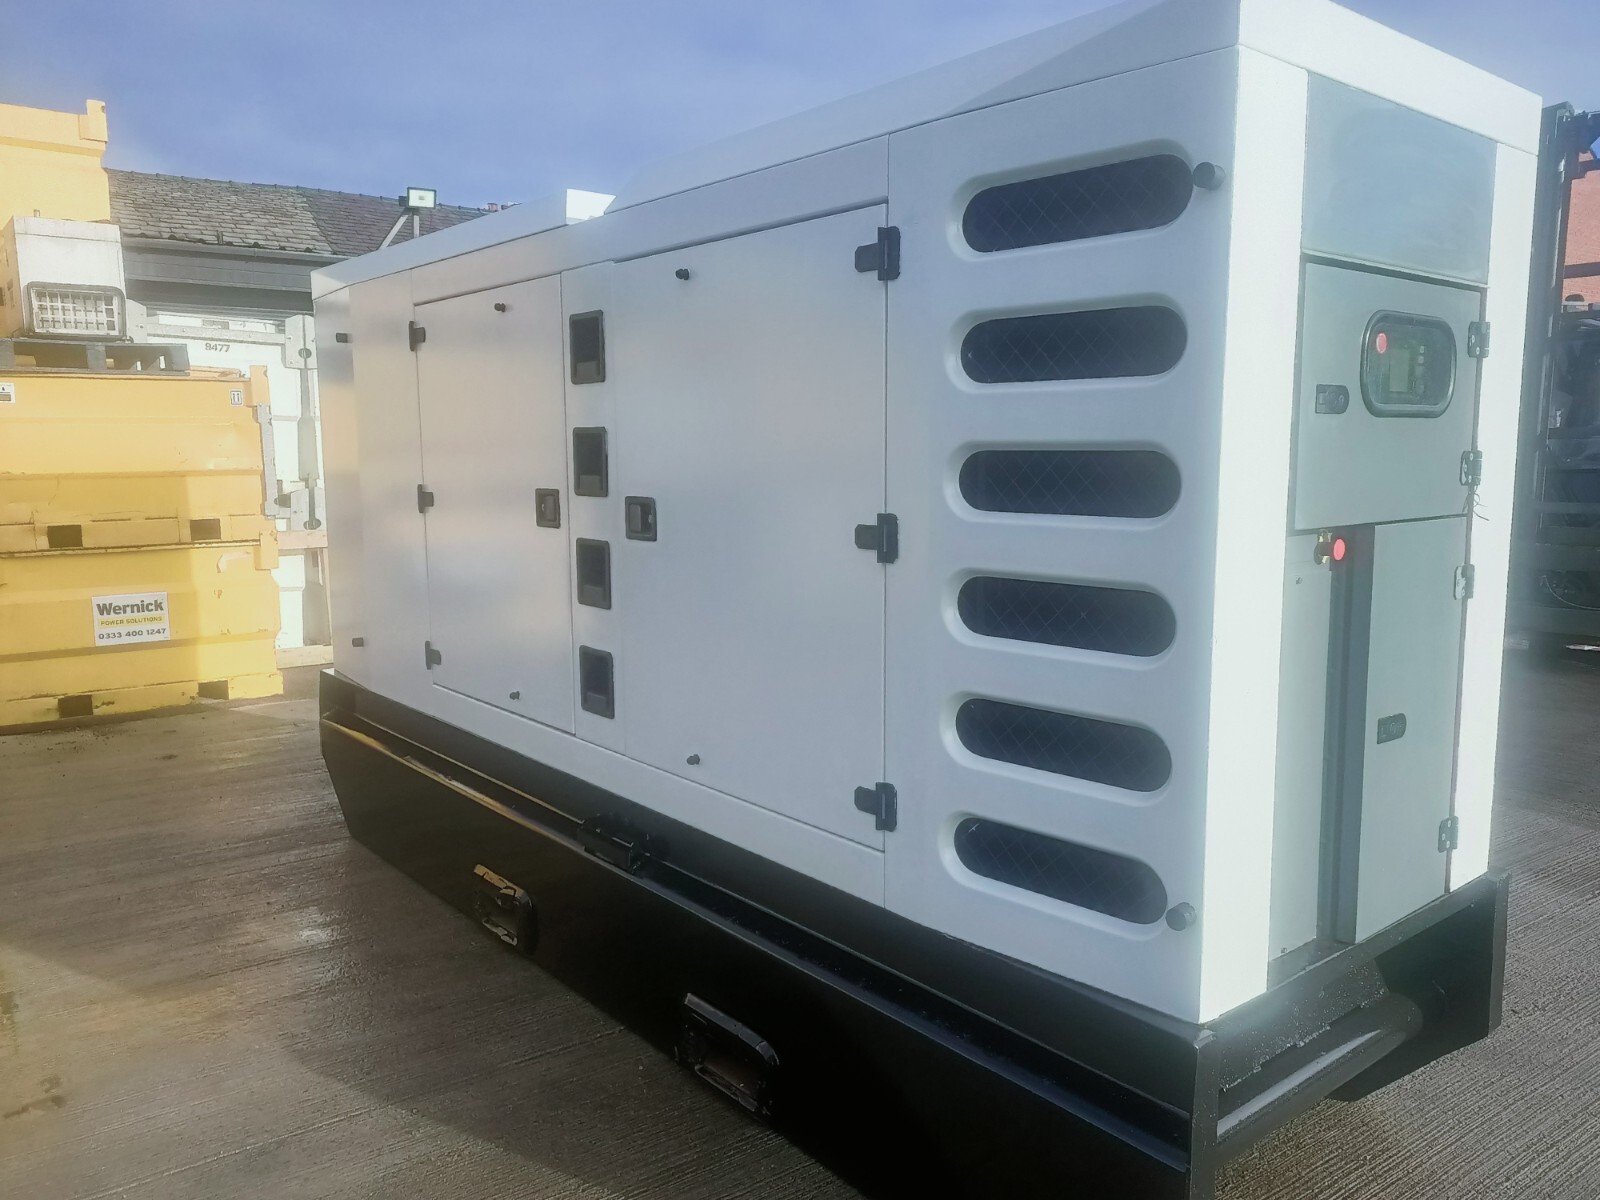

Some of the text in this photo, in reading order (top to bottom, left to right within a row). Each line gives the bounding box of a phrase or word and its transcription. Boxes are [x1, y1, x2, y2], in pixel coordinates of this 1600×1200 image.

[205, 342, 230, 352] 8477
[96, 600, 164, 616] Wernick
[126, 616, 162, 624] SOLUTIONS
[98, 632, 122, 640] 0333
[146, 628, 167, 636] 1247
